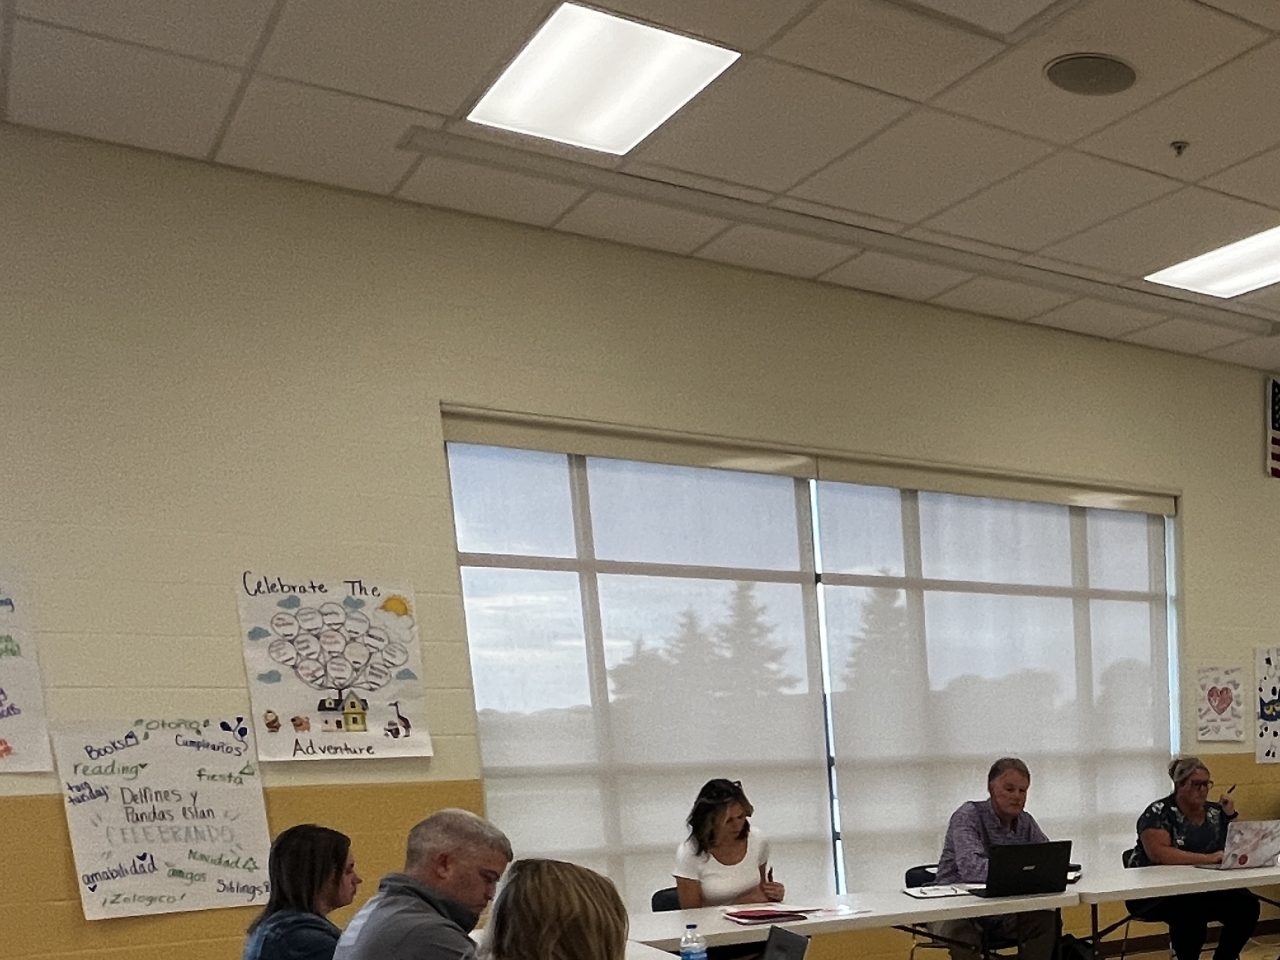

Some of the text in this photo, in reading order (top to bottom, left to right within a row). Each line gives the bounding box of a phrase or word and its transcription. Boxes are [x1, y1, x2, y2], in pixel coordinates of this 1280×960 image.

[242, 570, 381, 598] Celebrate The
[83, 740, 125, 760] Books
[293, 738, 375, 758] Adventure
[73, 760, 139, 781] reading
[196, 768, 244, 785] fiesta
[120, 786, 182, 805] Delfines
[124, 804, 174, 824] Pandas
[188, 849, 241, 869] Navidad
[81, 853, 158, 886] amabilidad
[216, 879, 264, 902] Siblings
